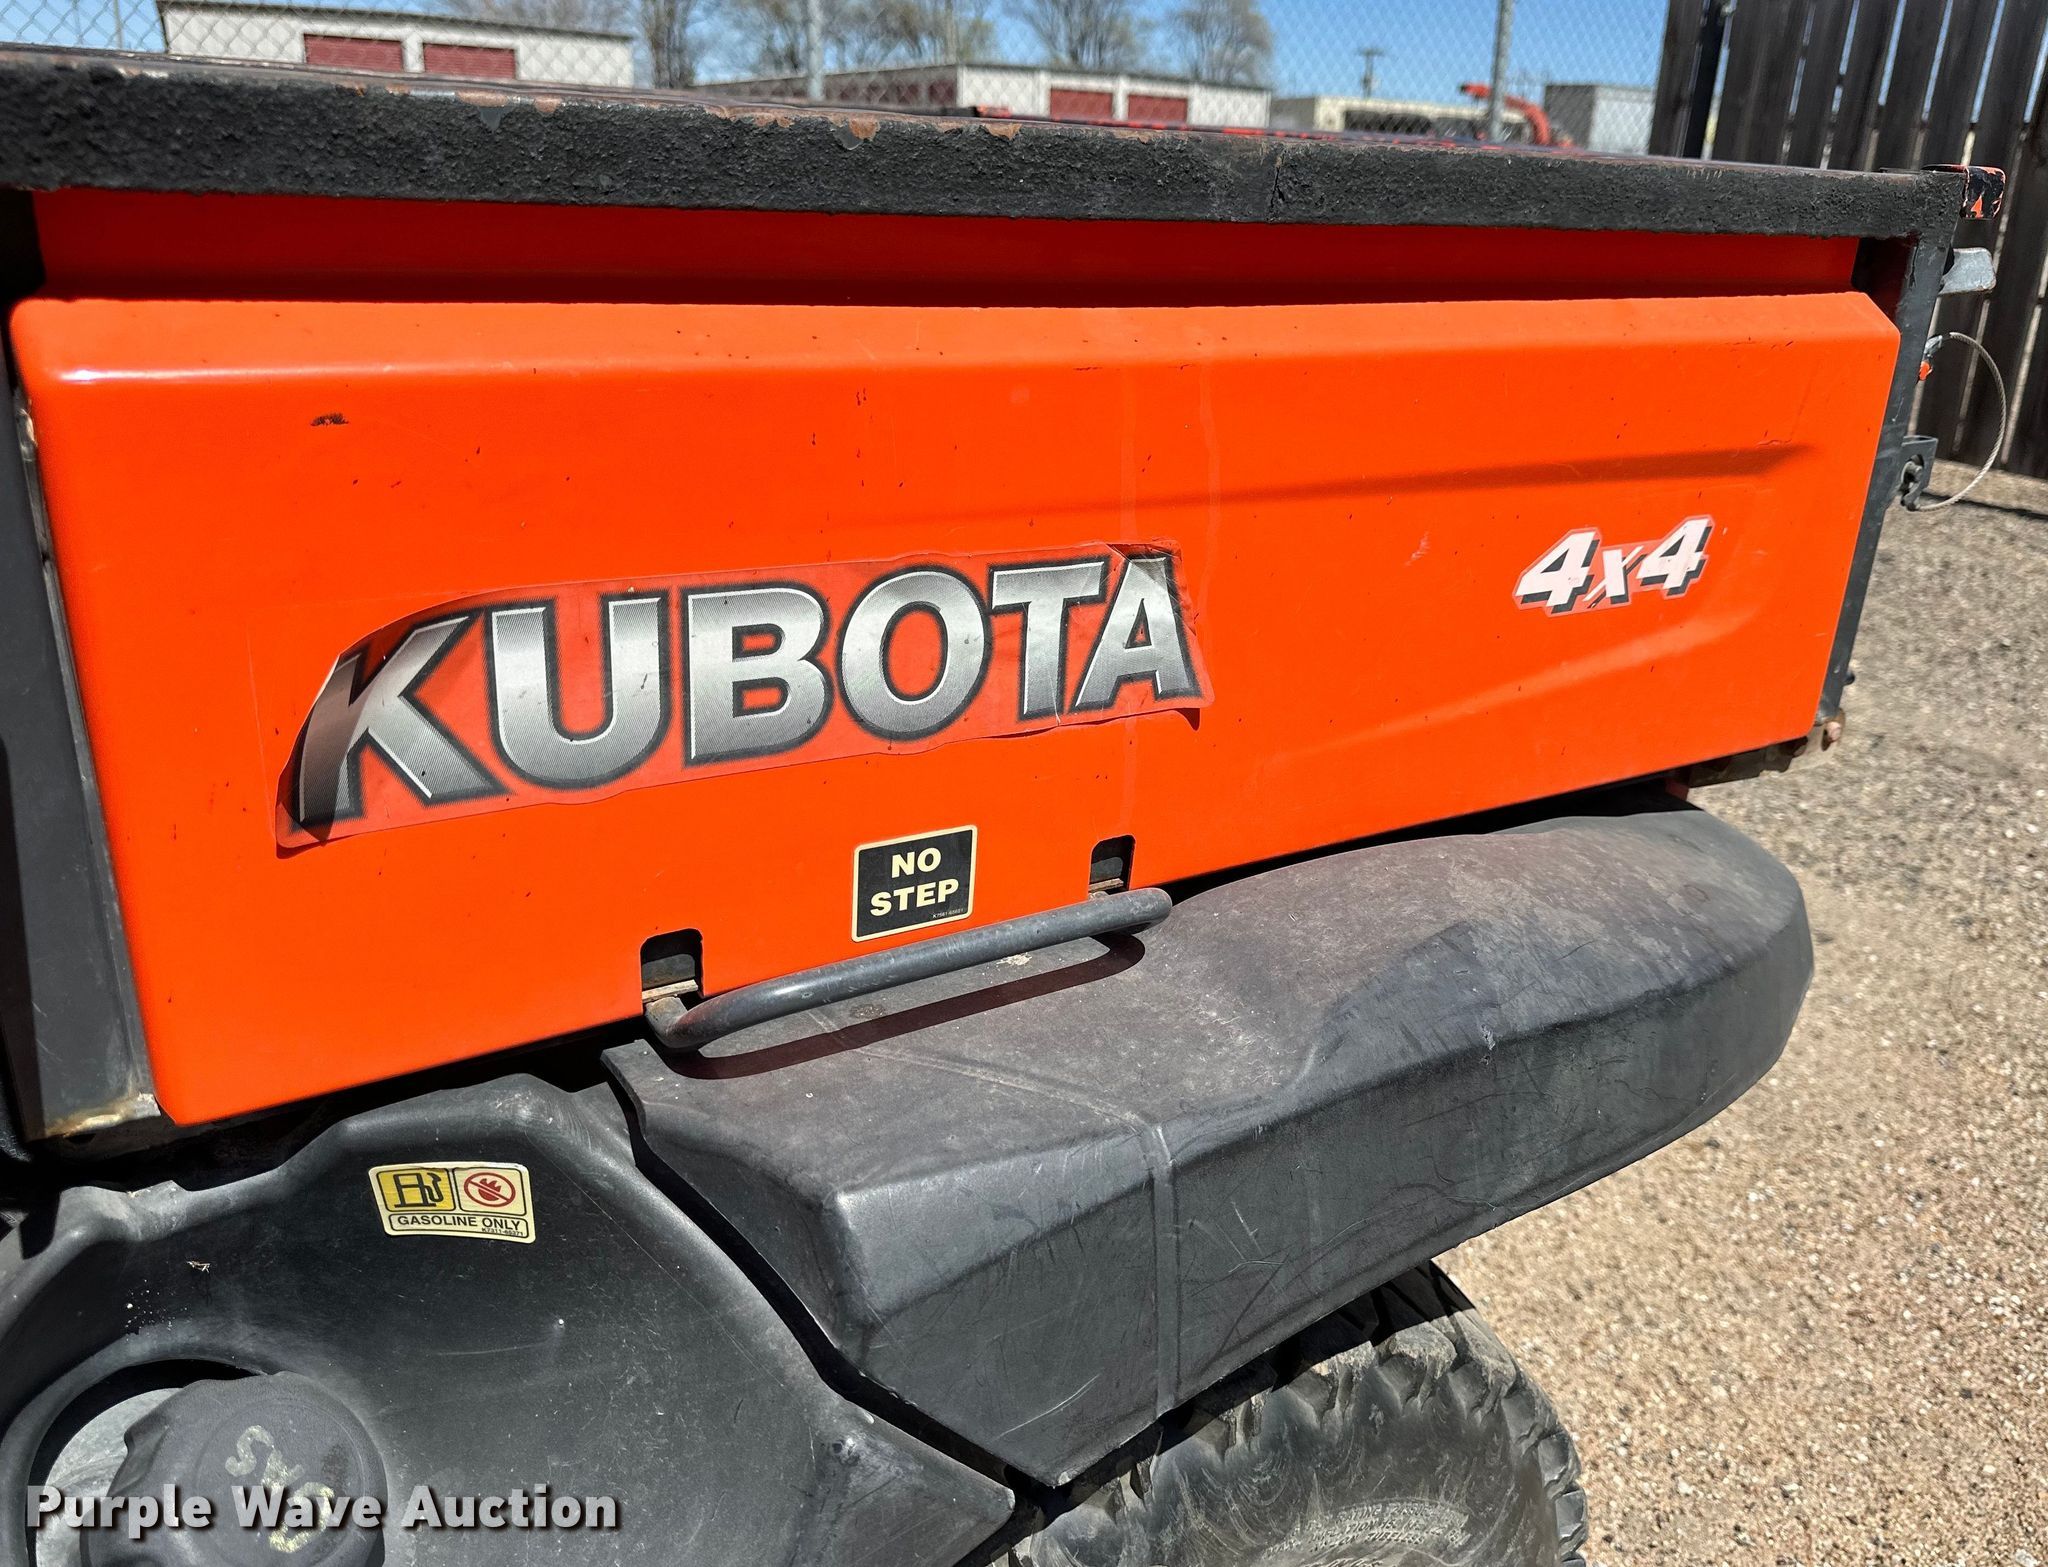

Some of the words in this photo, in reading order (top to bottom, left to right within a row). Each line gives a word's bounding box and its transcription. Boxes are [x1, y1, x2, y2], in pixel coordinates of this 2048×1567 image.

[1515, 519, 1712, 613] 4x4
[294, 549, 1200, 834] KUBOTA
[891, 847, 942, 878] NO
[870, 878, 960, 917] STEP
[397, 1215, 478, 1227] GASOLINE
[482, 1217, 521, 1231] ONLY
